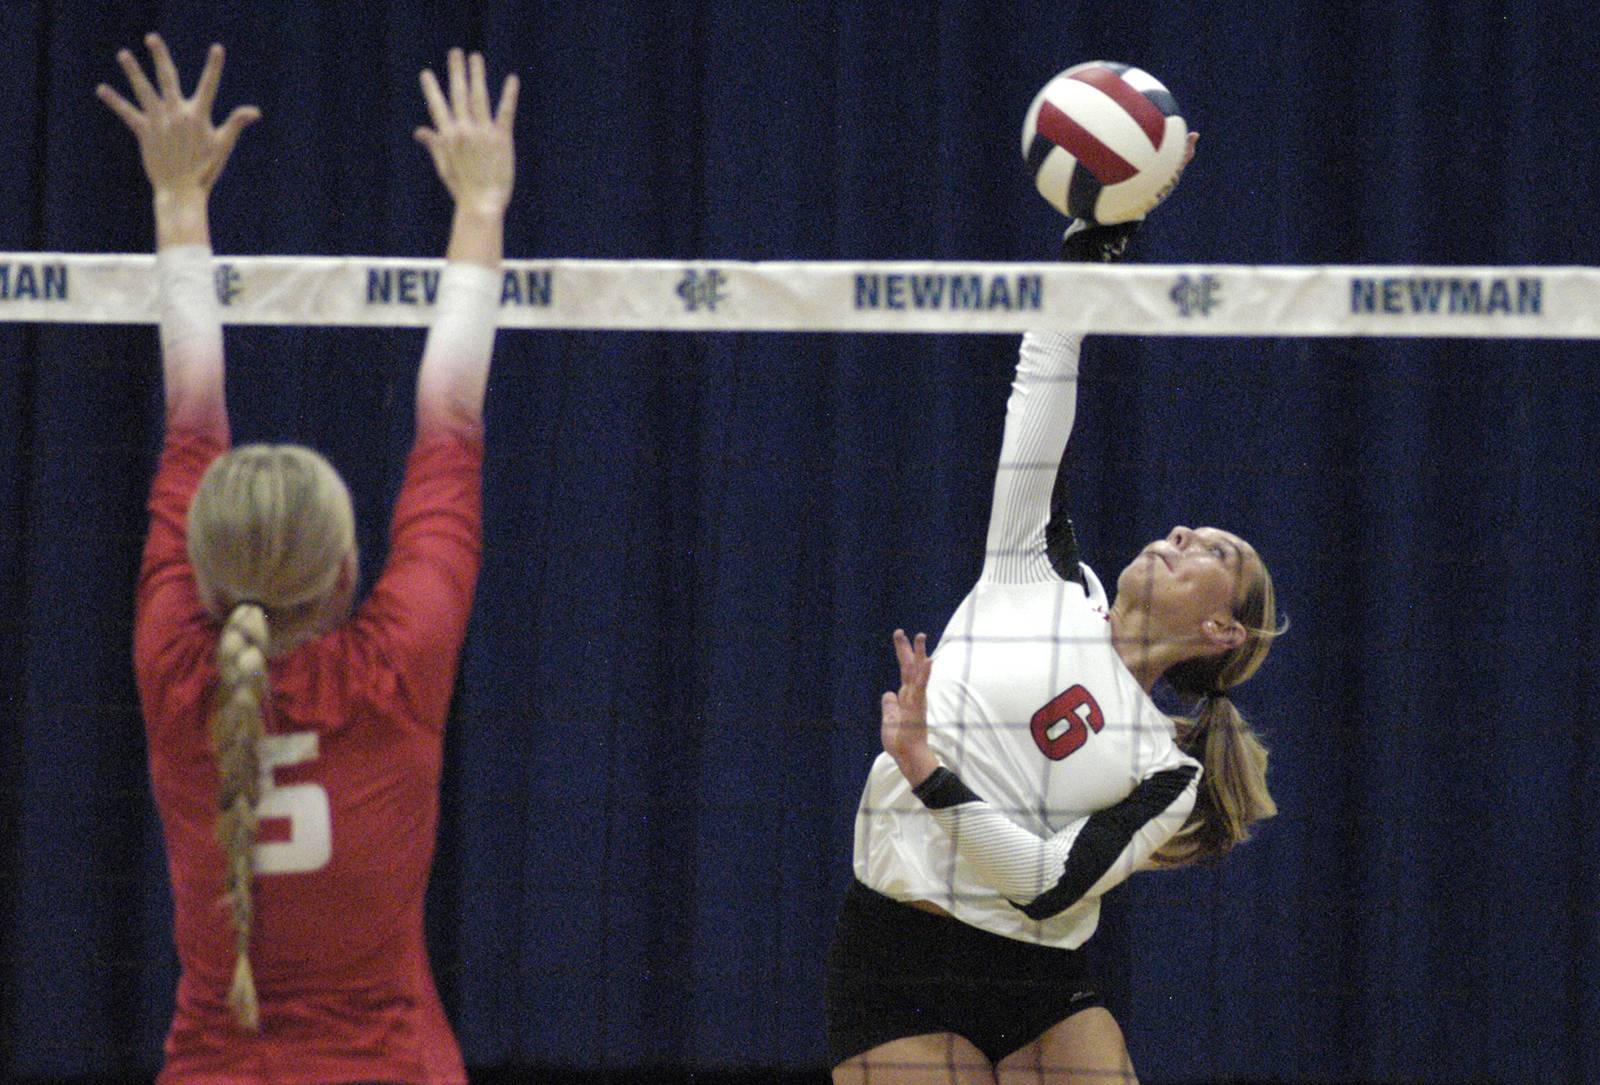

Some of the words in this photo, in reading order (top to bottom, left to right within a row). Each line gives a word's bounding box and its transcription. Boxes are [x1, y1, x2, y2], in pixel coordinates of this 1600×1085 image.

[367, 270, 553, 306] NEWAN
[855, 273, 1042, 311] NEWMAN
[1350, 278, 1543, 315] NEWMAN
[1030, 683, 1105, 761] 6
[248, 732, 332, 875] 5
